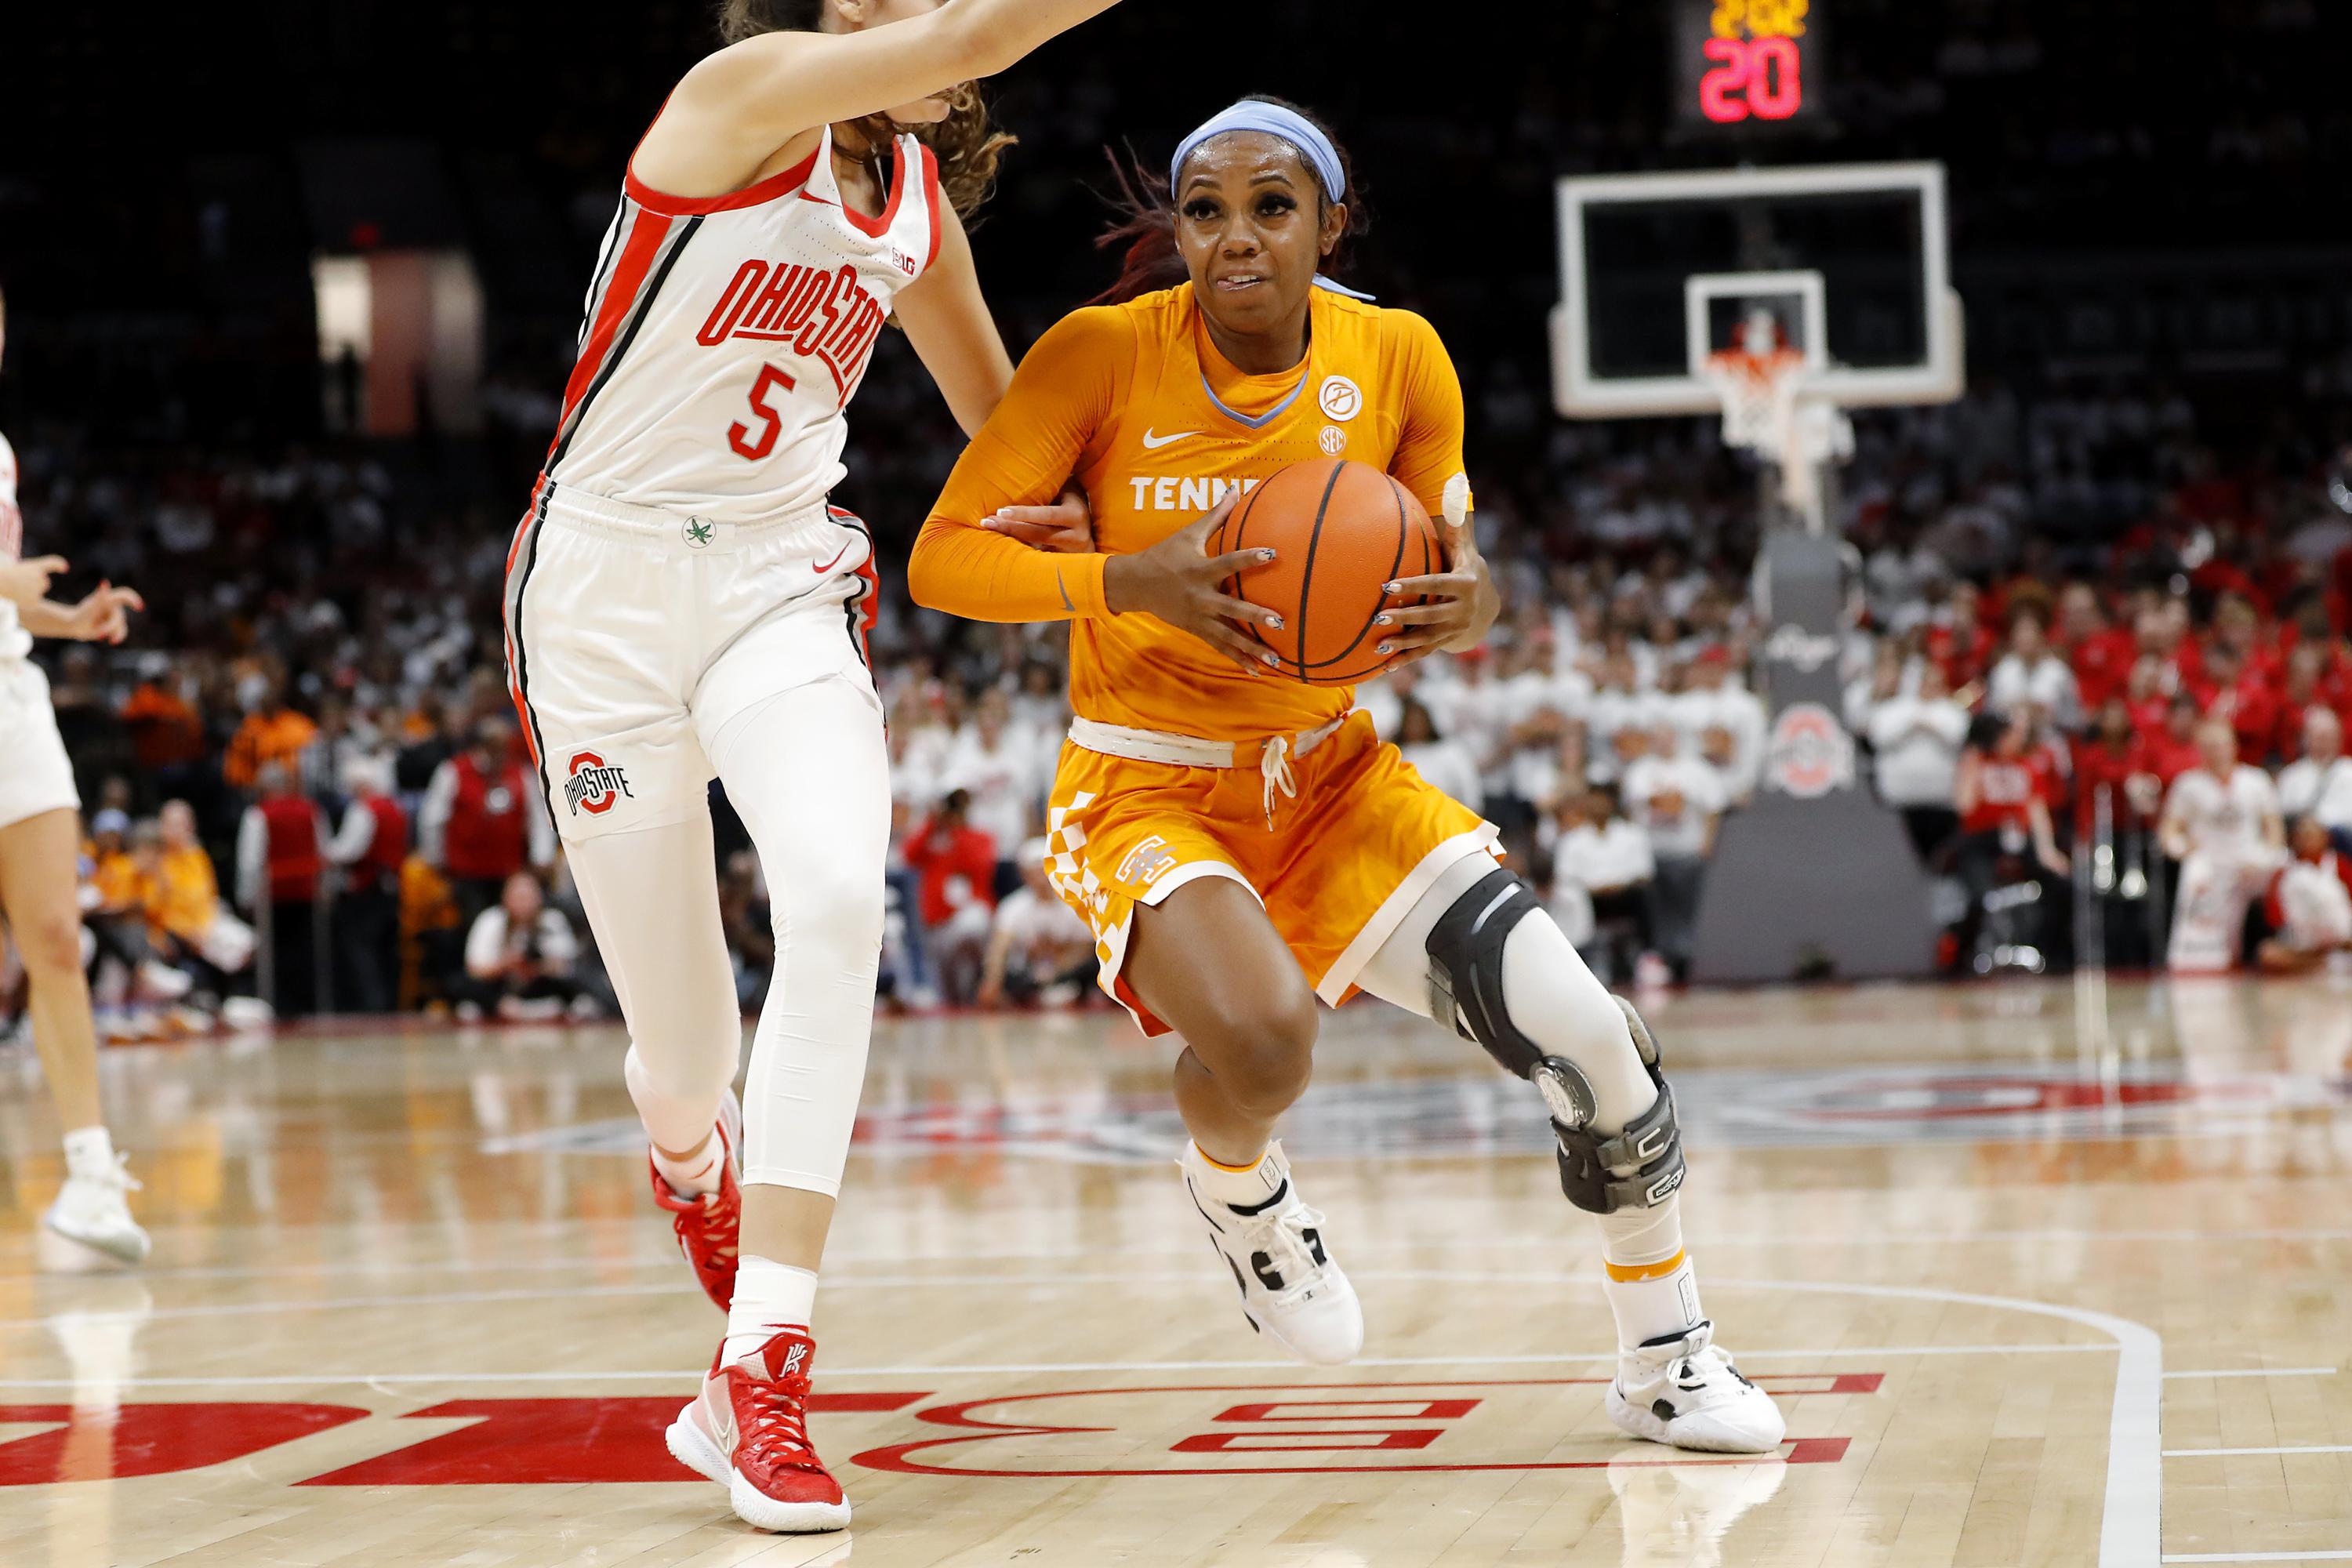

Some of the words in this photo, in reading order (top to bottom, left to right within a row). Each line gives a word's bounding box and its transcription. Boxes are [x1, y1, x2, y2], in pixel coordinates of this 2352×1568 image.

[1700, 34, 1802, 122] 20
[727, 361, 797, 463] 5
[1321, 427, 1344, 452] SEC
[1129, 477, 1261, 510] TENN
